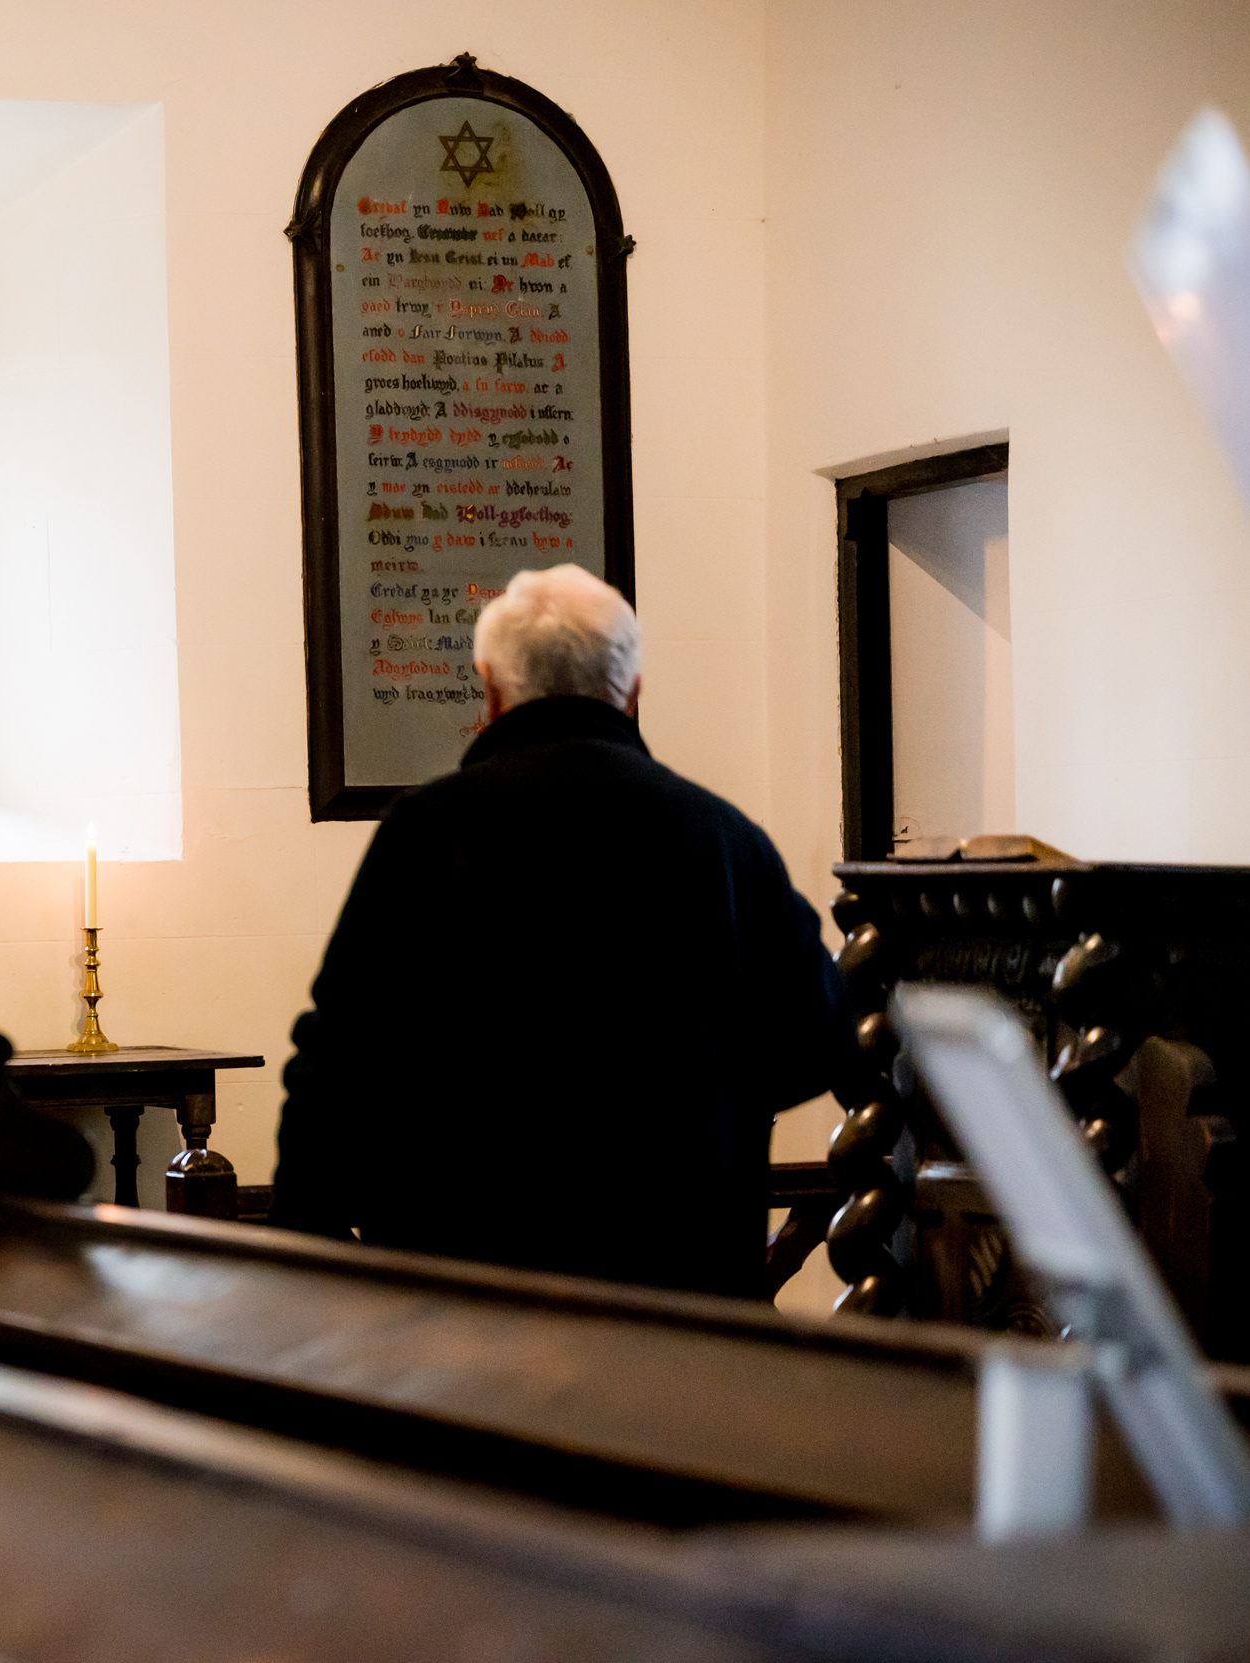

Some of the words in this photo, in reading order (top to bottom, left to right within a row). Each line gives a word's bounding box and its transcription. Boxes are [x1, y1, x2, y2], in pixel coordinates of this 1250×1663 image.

[413, 204, 431, 218] yn
[477, 200, 504, 218] Dad
[482, 227, 504, 242] nef
[508, 231, 516, 243] a
[386, 252, 404, 267] yn
[487, 252, 499, 266] ei
[501, 255, 518, 266] un
[521, 252, 555, 268] Mab
[362, 273, 380, 287] ein
[519, 276, 553, 294] hwn
[560, 283, 568, 294] a
[361, 298, 391, 317] gaed
[548, 304, 561, 320] A
[362, 323, 391, 338] aned
[398, 328, 405, 338] o
[409, 324, 441, 340] Fair
[509, 326, 522, 344] A
[530, 326, 569, 344] ddiodd
[362, 347, 396, 363] efodd
[402, 347, 425, 364] dan
[433, 350, 488, 371] Pontius
[552, 353, 567, 372] A
[462, 381, 469, 392] a
[475, 377, 489, 392] fu
[534, 383, 549, 394] ac
[555, 384, 563, 395] a
[434, 401, 447, 419] A
[453, 401, 527, 425] ddisgynodd
[530, 405, 536, 419] i
[367, 424, 383, 446] Y
[449, 426, 482, 447] dydd
[488, 432, 500, 448] y
[563, 435, 570, 445] o
[406, 451, 419, 471] A
[423, 454, 480, 474] esgynodd
[552, 455, 573, 473] Ac
[367, 481, 378, 496] y
[381, 482, 406, 494] mae
[412, 483, 431, 498] yn
[437, 480, 483, 495] eistedd
[488, 485, 500, 495] ar
[505, 479, 572, 497] ddeheulaw
[368, 529, 402, 546] Oddi
[404, 535, 429, 552] yno
[432, 535, 443, 552] y
[447, 531, 476, 547] daw
[479, 531, 485, 547] i
[532, 531, 561, 554] byw
[566, 537, 573, 548] a
[370, 582, 418, 598] Credaf
[441, 587, 459, 606] yr
[371, 607, 423, 630] Eglwys
[428, 608, 450, 624] lan
[369, 638, 381, 656] y
[372, 659, 450, 681] Adgyfodiad
[456, 664, 469, 681] y
[373, 686, 400, 705] wyd
